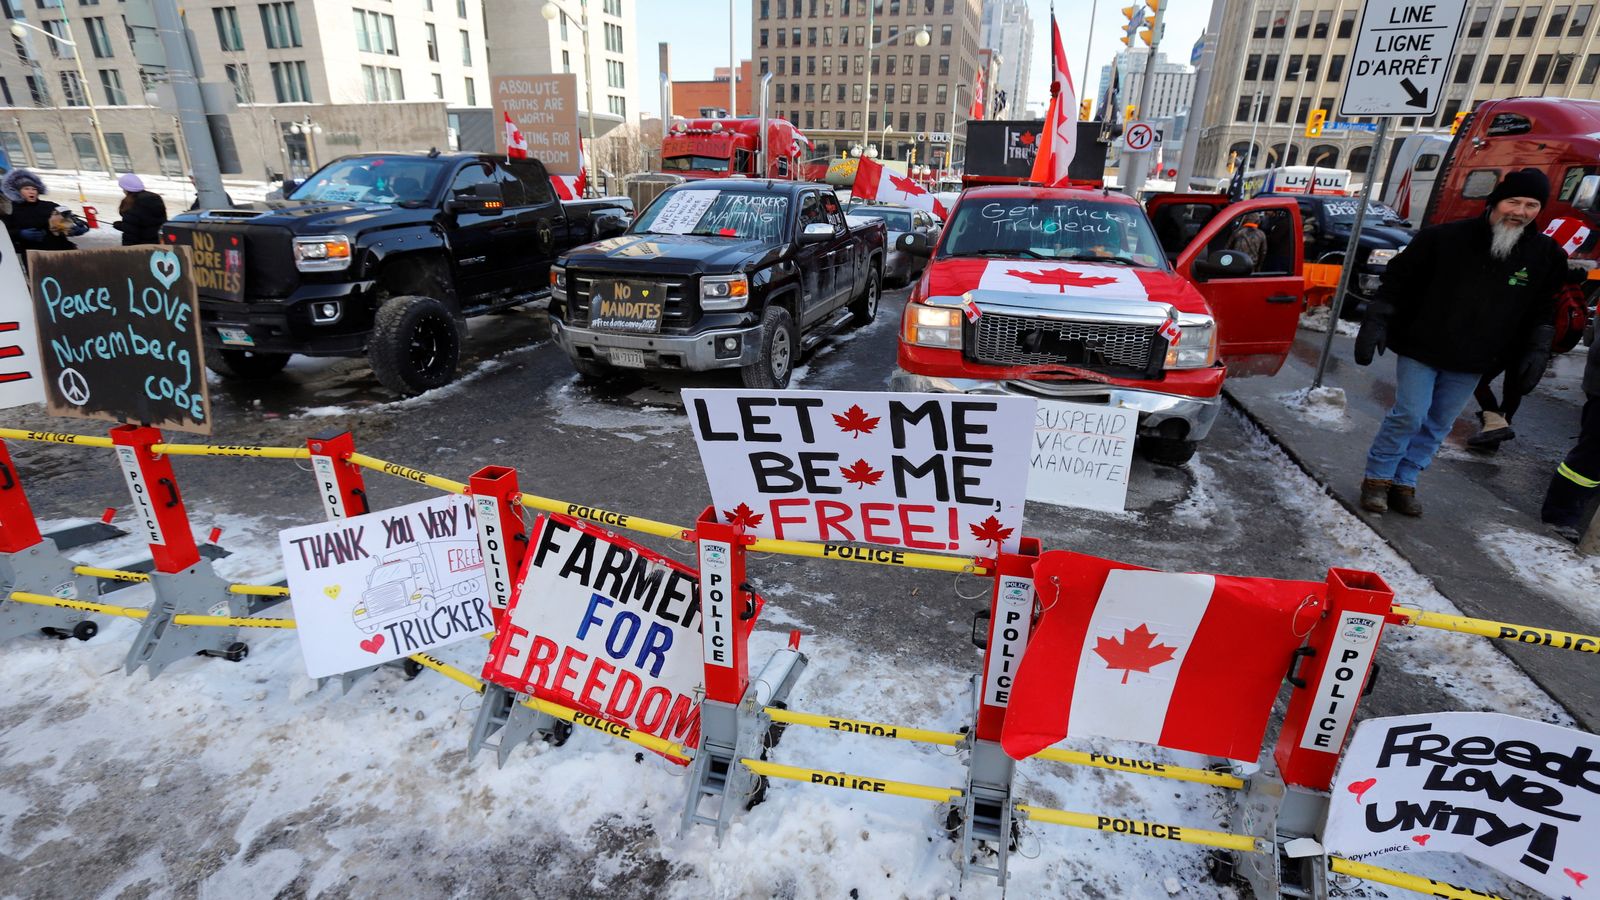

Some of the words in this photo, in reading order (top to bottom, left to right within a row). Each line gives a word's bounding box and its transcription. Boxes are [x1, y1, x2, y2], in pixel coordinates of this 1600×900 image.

[1389, 5, 1436, 24] LINE
[1375, 34, 1434, 52] LIGNE
[1357, 55, 1442, 76] D'ARRÊT
[499, 80, 559, 94] ABSOLUTE
[502, 99, 539, 111] TRUTHS
[544, 98, 564, 111] ARE
[517, 112, 554, 124] WORTH
[553, 131, 571, 146] FOR
[664, 143, 727, 153] FREEDOM
[527, 150, 569, 164] REEDOM
[725, 195, 788, 208] TRUCKERS
[981, 203, 1039, 219] Get
[706, 211, 774, 224] WAITING
[992, 218, 1111, 237] Trudeau
[192, 231, 214, 251] NO
[193, 250, 222, 270] ORE
[614, 282, 631, 300] NO
[128, 277, 192, 332] LOVE
[600, 300, 660, 319] MANDATES
[51, 324, 192, 390] Nuremberg
[694, 396, 823, 443] LET
[888, 399, 998, 453] ME
[1035, 407, 1127, 435] SUSPEND
[1035, 432, 1126, 457] VACCINE
[384, 463, 427, 483] POLICE
[748, 451, 842, 494] BE
[130, 471, 160, 541] POLICE
[325, 482, 340, 517] POL
[567, 504, 629, 527] POLICE
[769, 498, 960, 551] FREE!
[289, 525, 370, 571] THANK
[381, 515, 415, 549] YOU
[417, 505, 457, 540] VERY
[823, 544, 905, 564] POLICE
[485, 525, 507, 606] POLICE
[384, 597, 494, 655] TRUCKER
[709, 574, 724, 662] POLICE
[1346, 616, 1375, 628] POLICE
[576, 592, 674, 679] FOR
[1498, 626, 1600, 653] POLIC
[995, 611, 1020, 703] POLICE
[495, 623, 701, 750] FREEDOM
[1314, 649, 1359, 748] POLICE
[573, 711, 631, 740] POLICE
[829, 720, 897, 738] POLICE
[1090, 752, 1166, 772] POLICE
[811, 773, 885, 793] POLICE
[1097, 816, 1181, 841] POLICE
